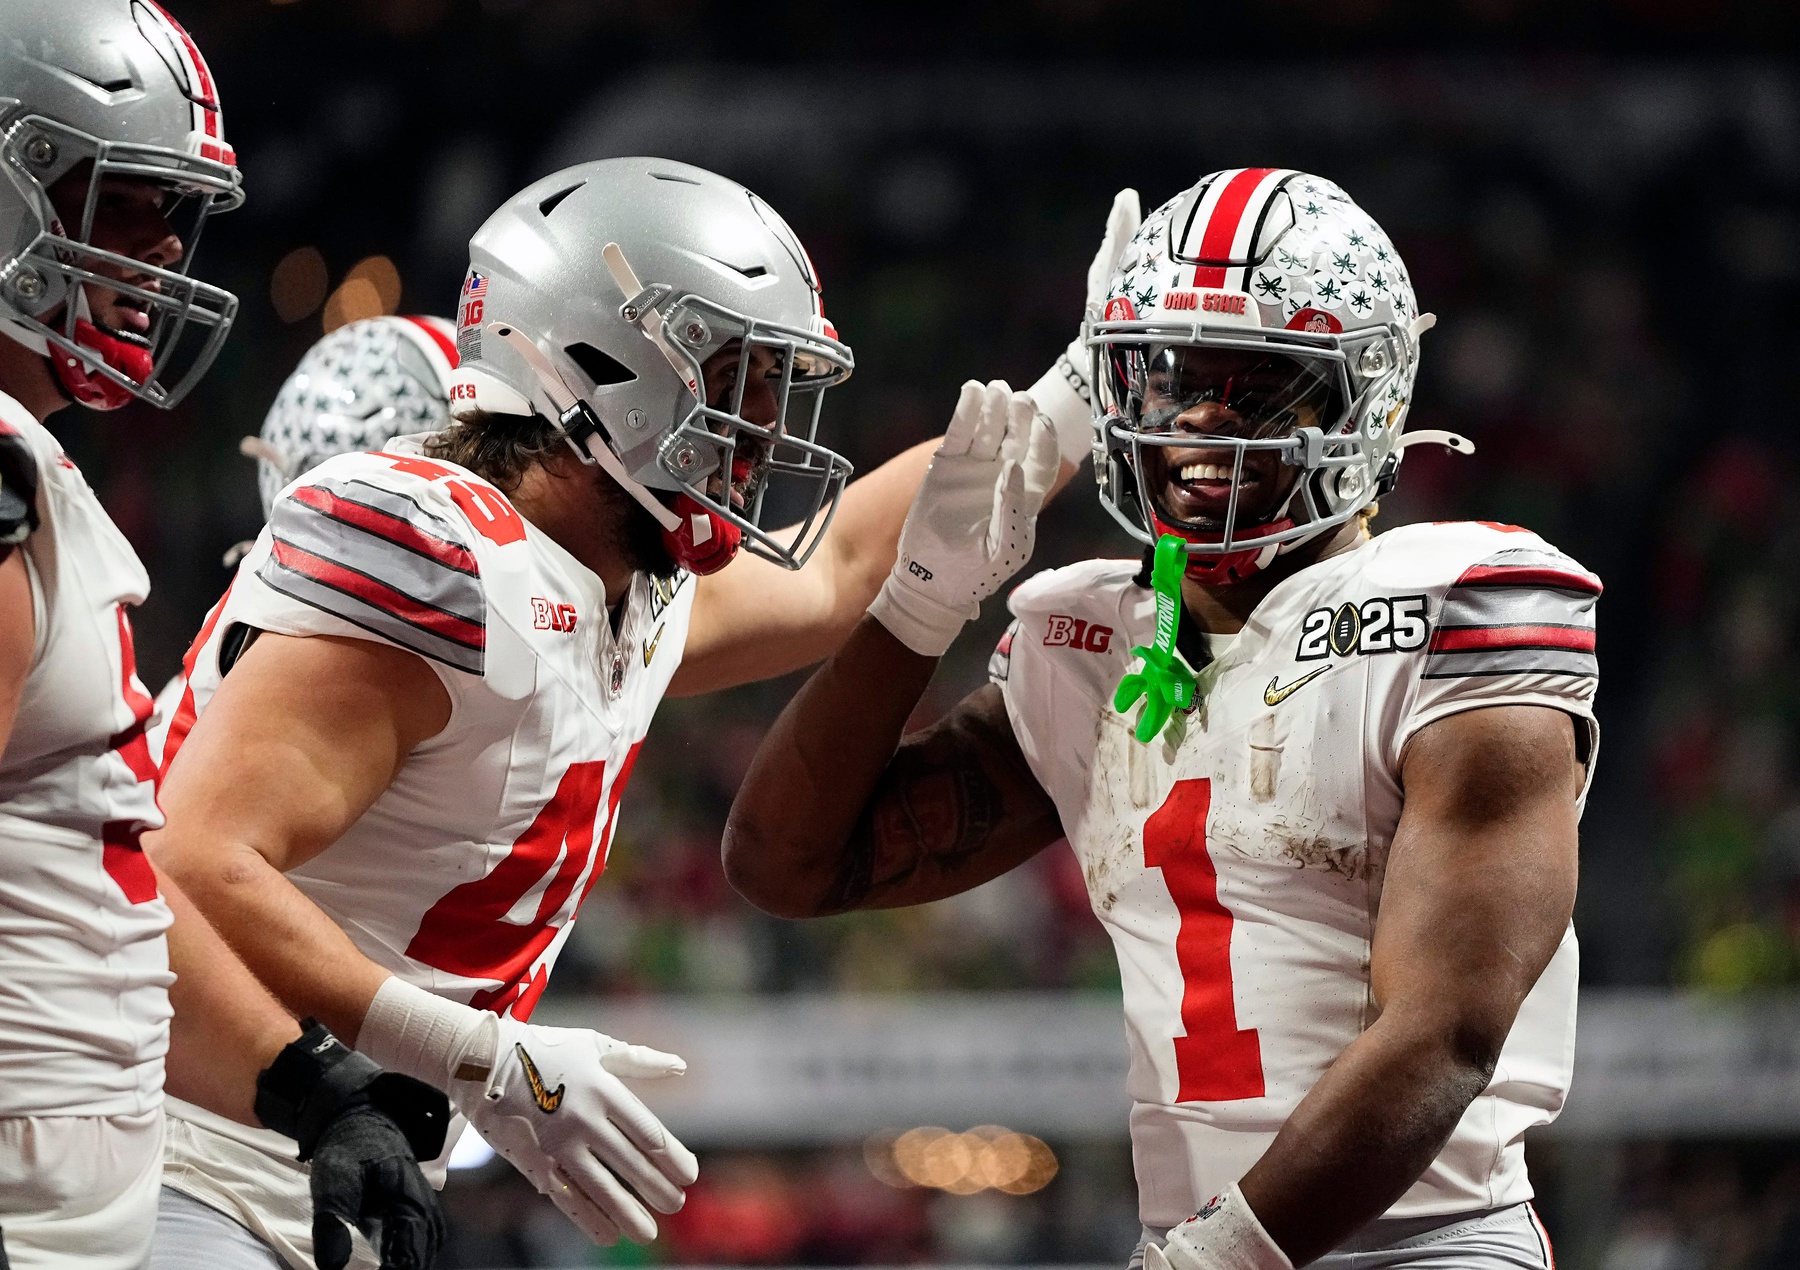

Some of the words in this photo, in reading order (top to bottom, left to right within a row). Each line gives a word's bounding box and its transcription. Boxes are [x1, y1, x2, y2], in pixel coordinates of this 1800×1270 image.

[1163, 292, 1198, 310] OHIO
[1202, 293, 1247, 315] STATE
[908, 561, 933, 581] CFP
[1156, 591, 1175, 654] NXTRND
[1143, 777, 1265, 1103] 1
